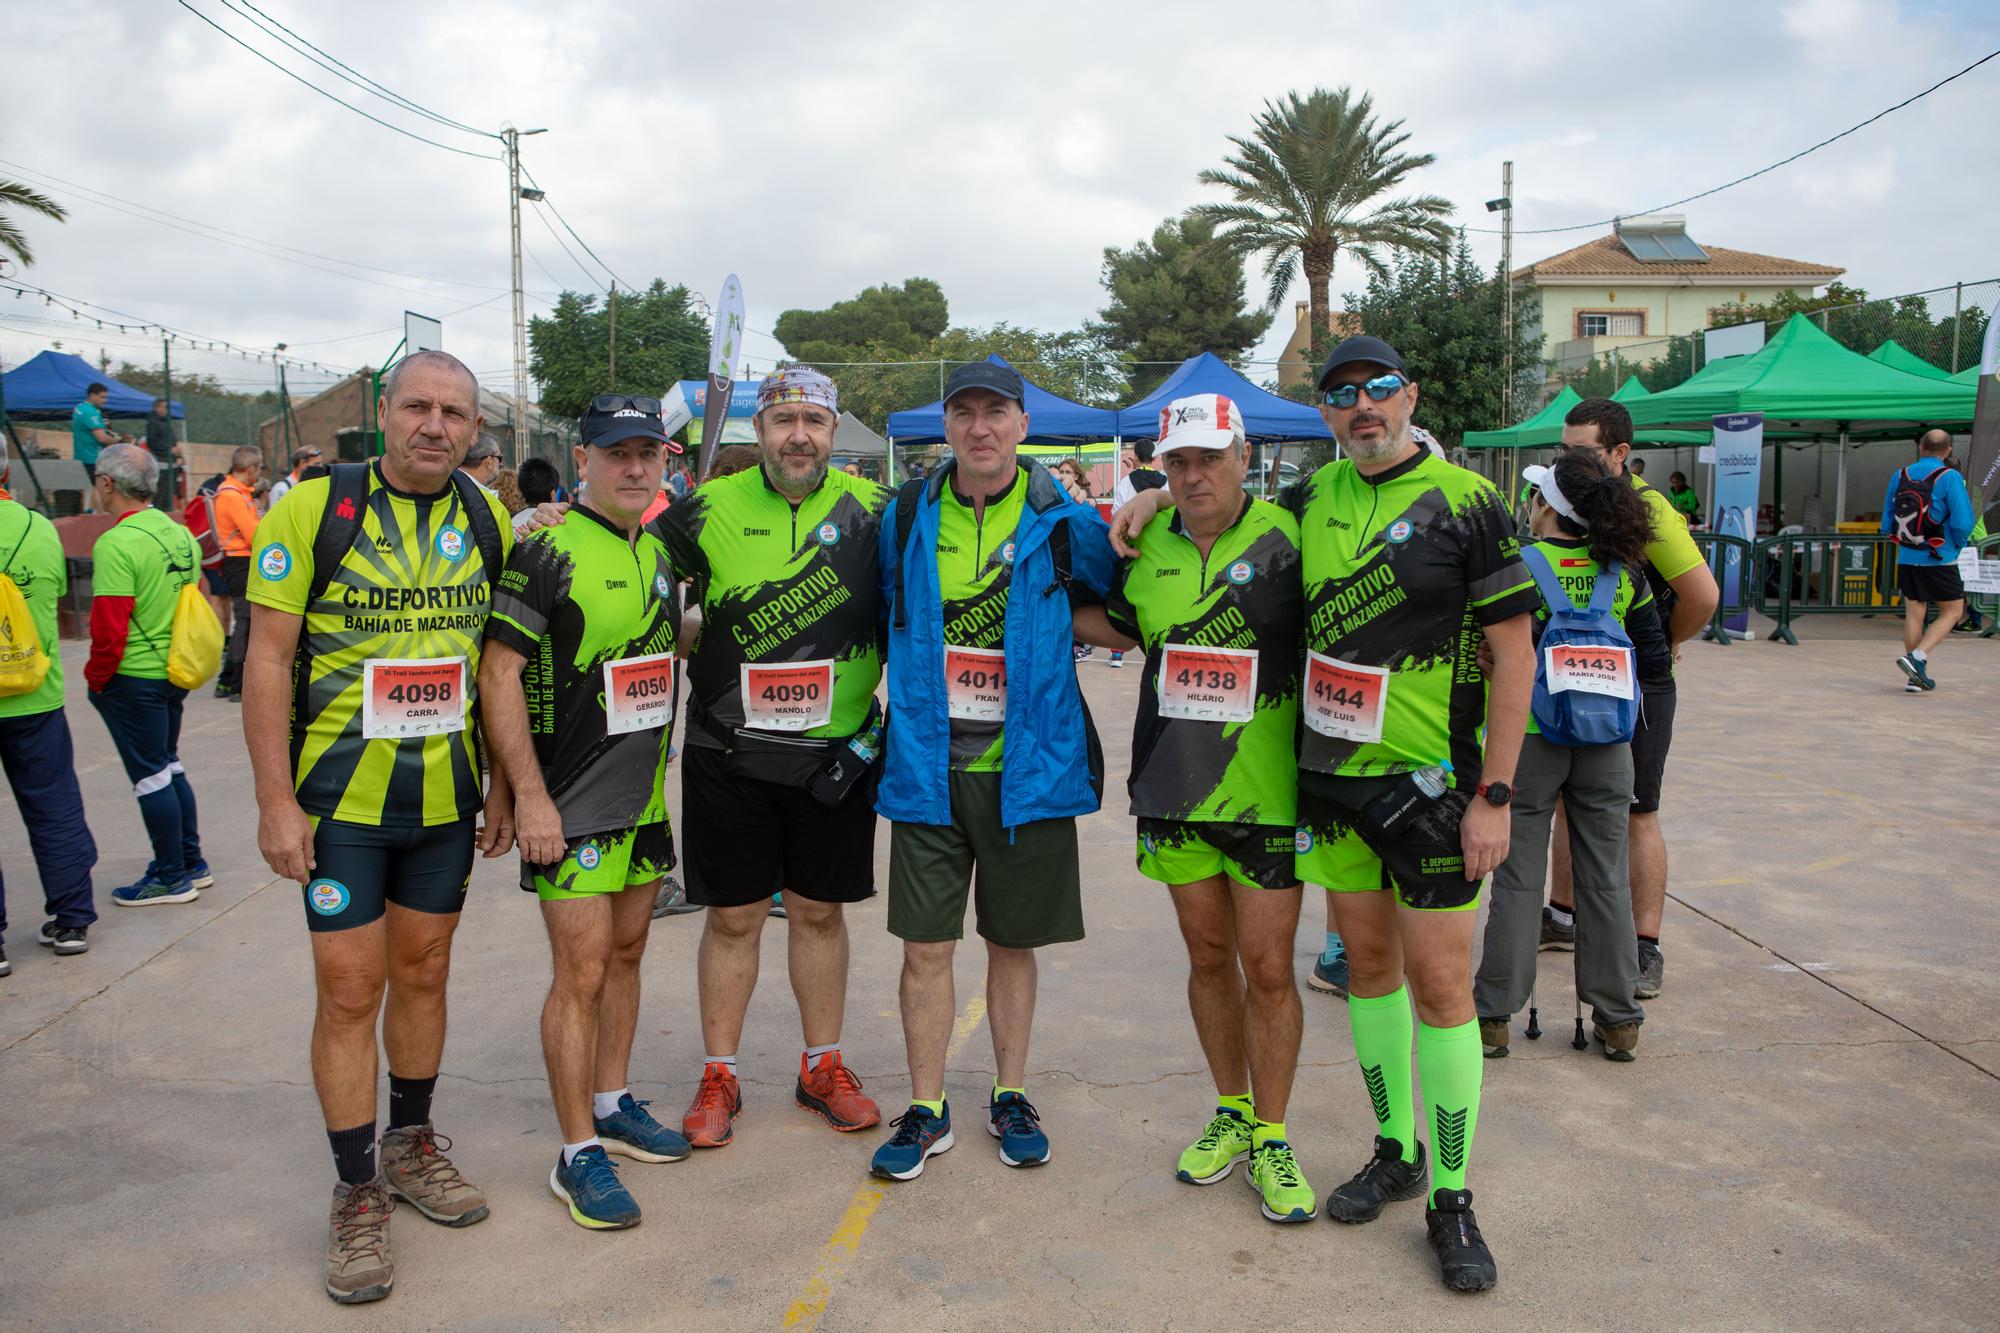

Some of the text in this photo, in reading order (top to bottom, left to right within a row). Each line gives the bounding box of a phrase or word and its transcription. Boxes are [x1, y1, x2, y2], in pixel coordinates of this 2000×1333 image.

[732, 624, 754, 645] C.
[747, 565, 839, 634] DEPORTIVO
[1310, 563, 1396, 636] DEPORTIVO
[344, 611, 486, 633] BAHÍA DE MAZARRÓN
[744, 584, 852, 661] BAHÍA DE MAZARRÓN
[944, 586, 1010, 645] EPORTIV
[1326, 624, 1343, 645] DE
[1342, 585, 1408, 634] MAZARRÓN
[1467, 621, 1482, 683] PORTIVO
[1564, 657, 1617, 672] 4143
[626, 676, 667, 699] 4050
[1176, 668, 1237, 690] 4138
[1596, 673, 1617, 681] JOSE
[387, 682, 452, 704] 4098
[542, 687, 554, 701] DE
[762, 683, 819, 702] 4090
[975, 694, 1000, 703] FRAN
[1187, 693, 1225, 703] HILARIO
[1314, 680, 1364, 709] 4144
[406, 708, 439, 718] CARRA
[636, 700, 666, 712] GERARDO
[775, 706, 812, 714] MANOLO
[1334, 711, 1356, 722] LUIS
[540, 703, 555, 734] BAHÍA
[1273, 837, 1296, 846] DEPORT
